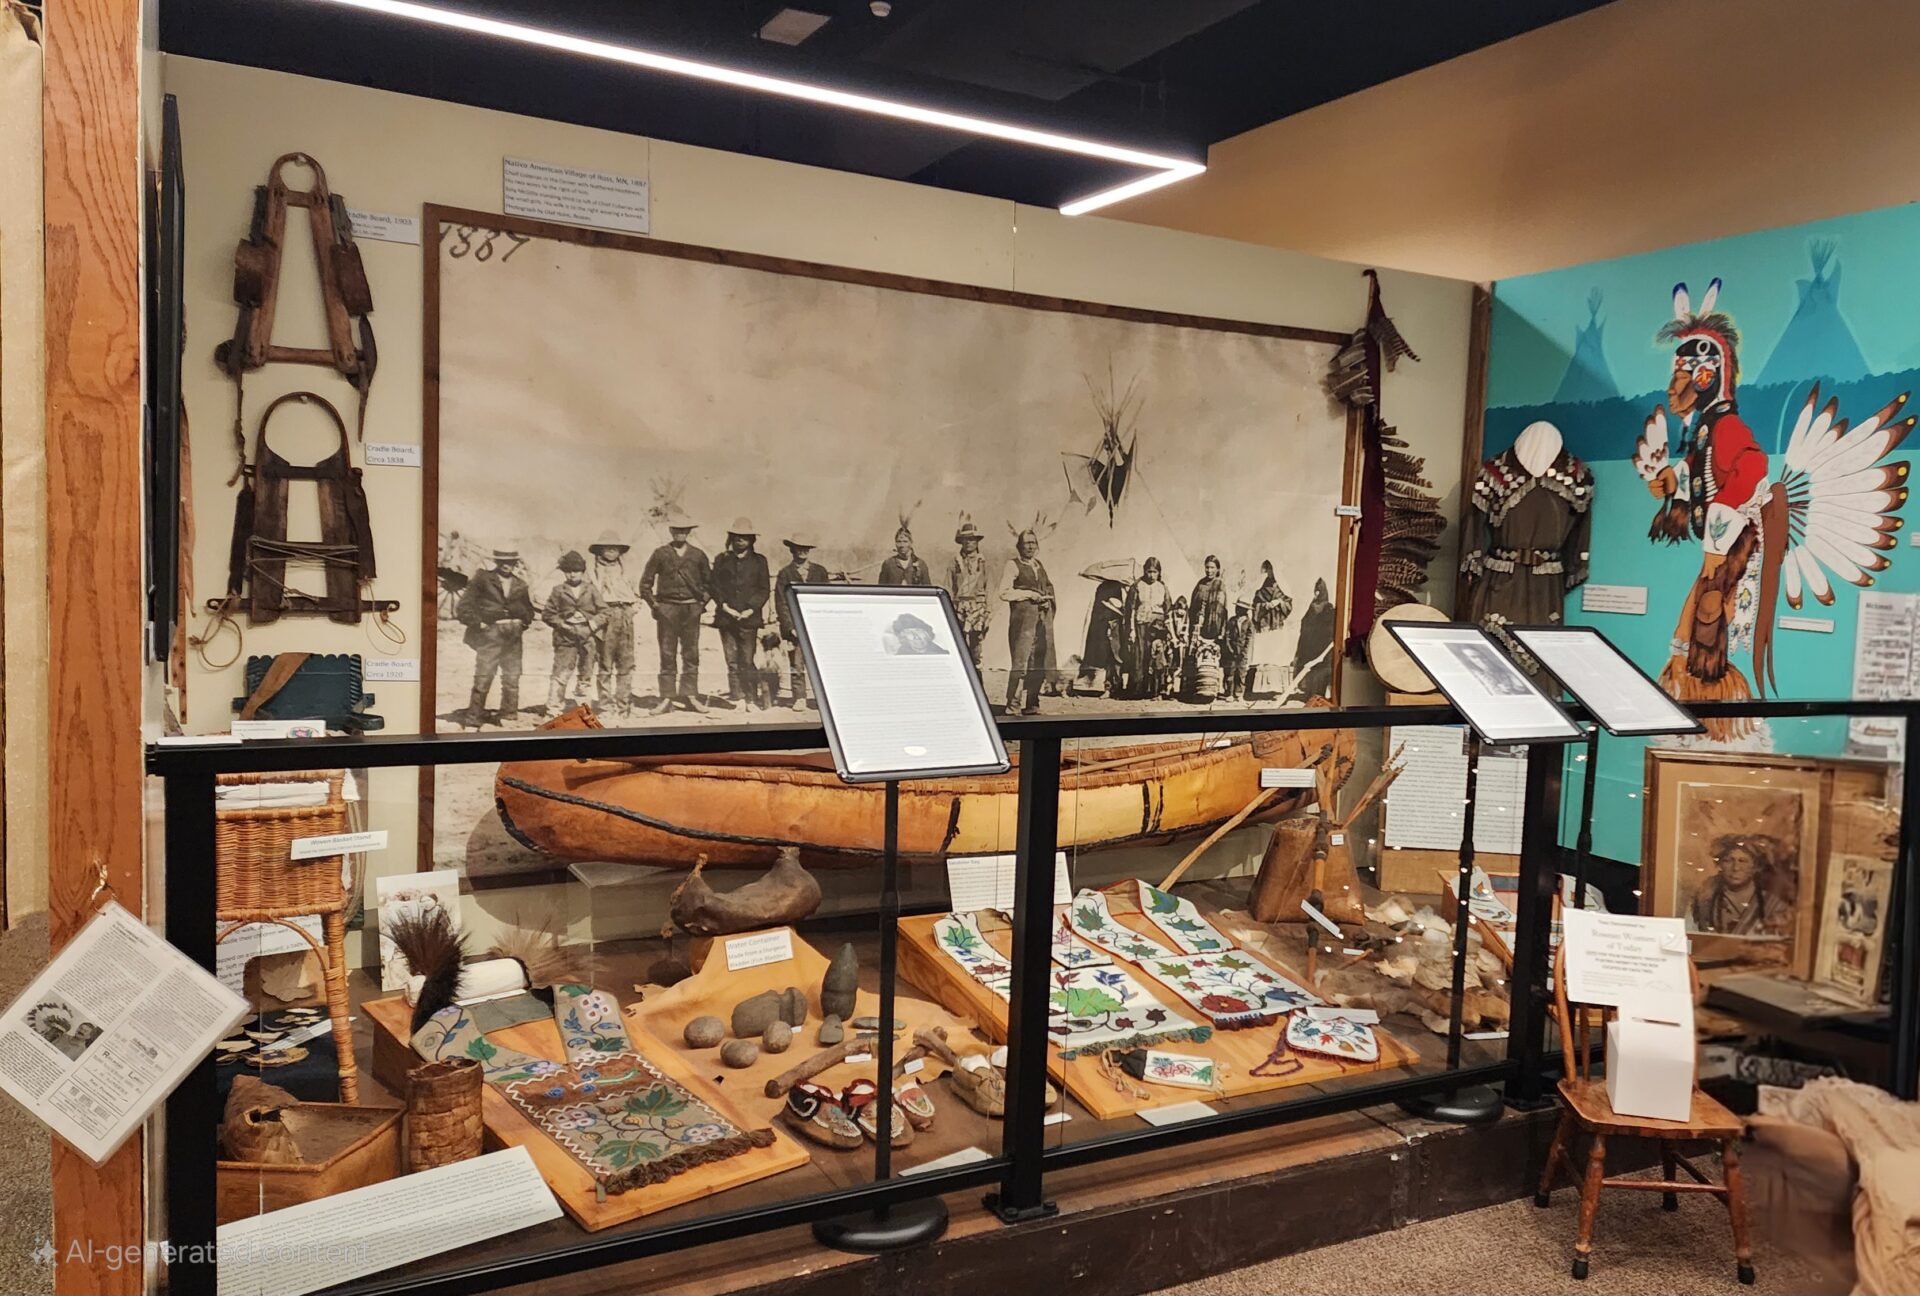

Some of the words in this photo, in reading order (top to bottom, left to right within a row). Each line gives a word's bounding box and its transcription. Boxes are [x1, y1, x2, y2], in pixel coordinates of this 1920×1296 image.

[505, 159, 527, 168] Native
[530, 163, 563, 174] American
[564, 168, 587, 179] Village
[349, 212, 368, 221] radle
[370, 214, 392, 224] Board,
